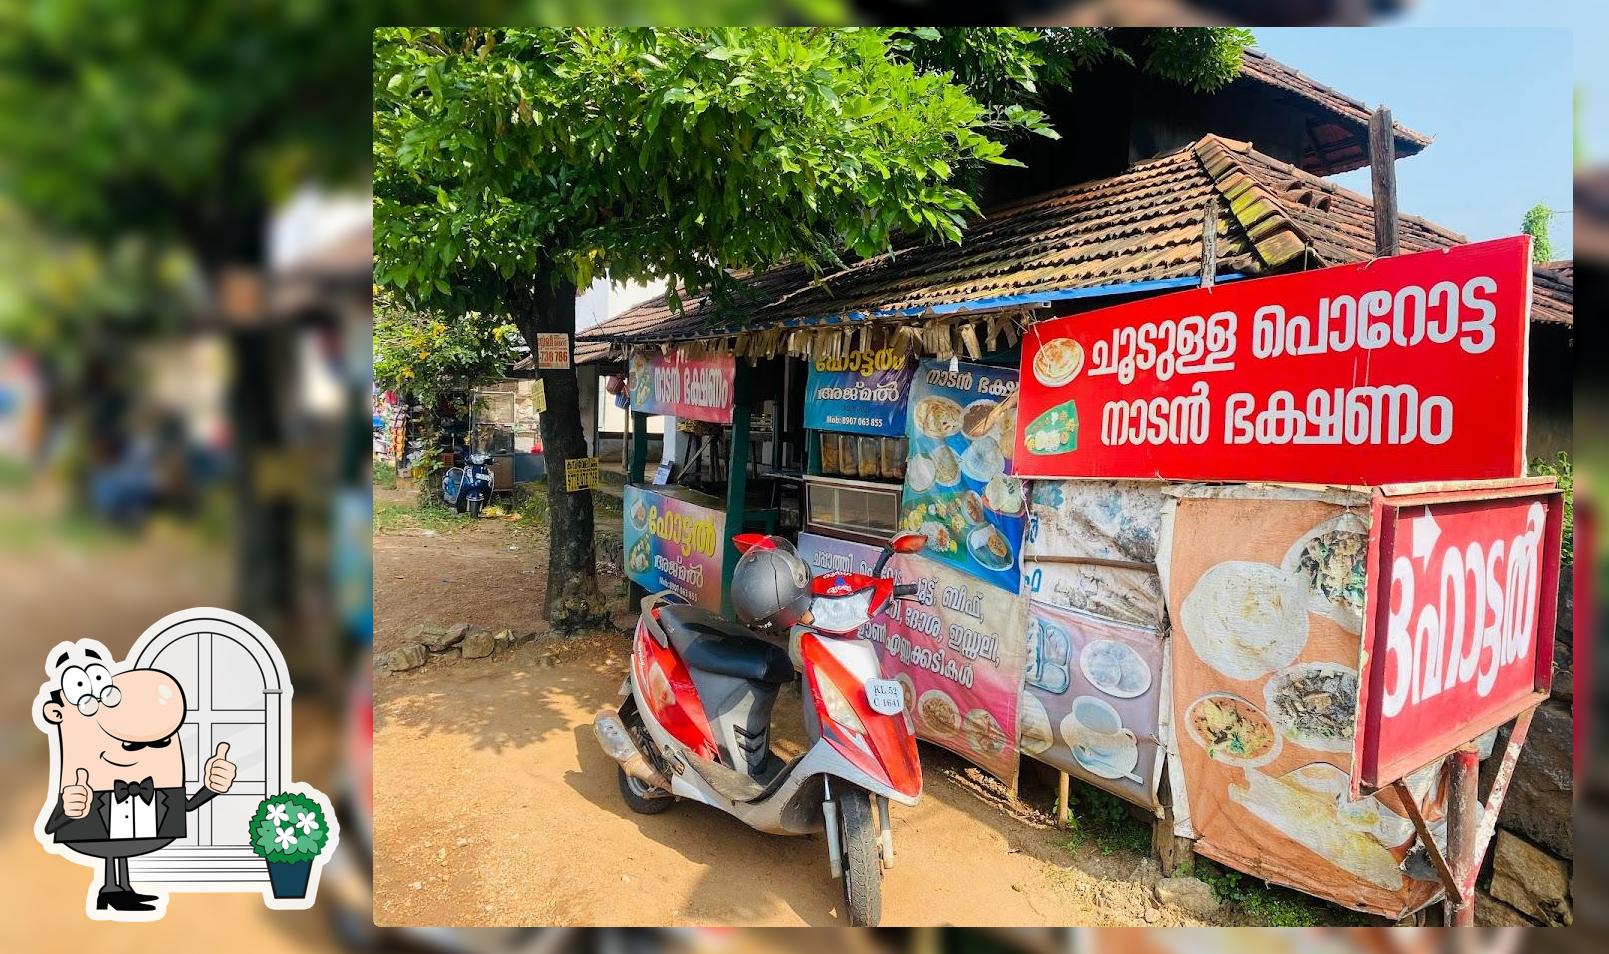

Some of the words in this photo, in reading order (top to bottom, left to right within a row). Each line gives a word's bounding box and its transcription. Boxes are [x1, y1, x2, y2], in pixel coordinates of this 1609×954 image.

[1087, 311, 1237, 385] ചൂടുള്ള
[1252, 276, 1497, 355] പൊറോട്ട
[654, 366, 681, 404] നാടൻ
[683, 366, 729, 409] ഭക്ഷണം
[817, 381, 900, 402] അജ്മൽ
[926, 369, 973, 391] നാടൻ
[977, 376, 1019, 397] ഭക്ഷ
[1100, 381, 1209, 447] നാടൻ
[1225, 383, 1453, 446] ഭക്ഷണം
[649, 505, 717, 559] ഹോട്ടൽ
[654, 554, 704, 588] അജ്മൽ
[905, 607, 943, 643] ദോശ,
[1381, 501, 1545, 718] ഹോട്ടൽ
[874, 685, 887, 695] KL
